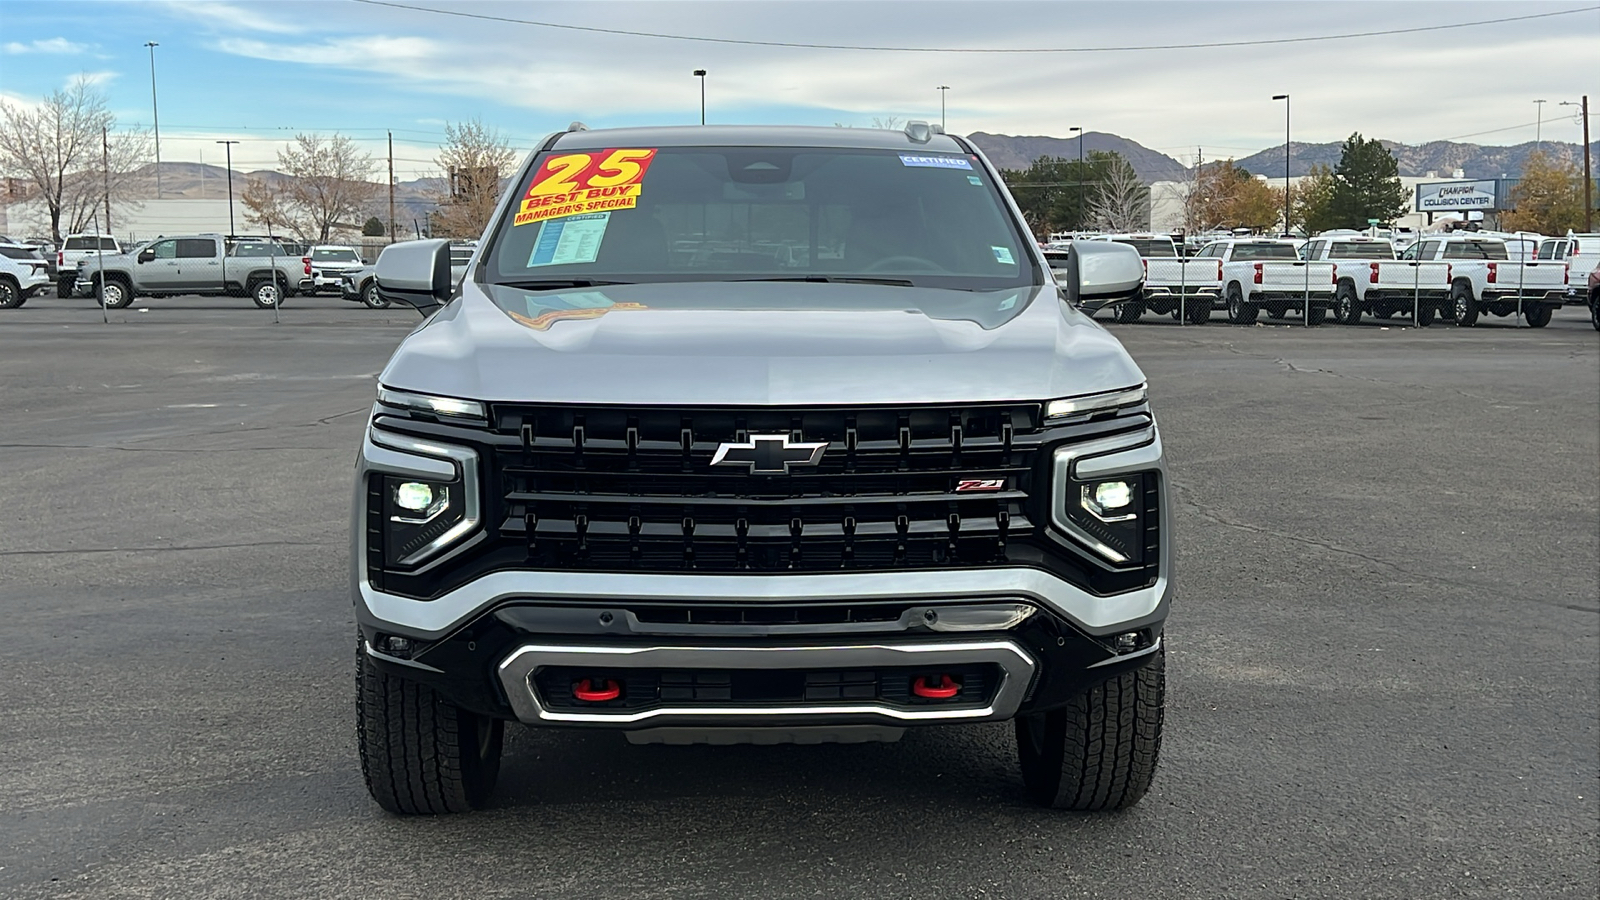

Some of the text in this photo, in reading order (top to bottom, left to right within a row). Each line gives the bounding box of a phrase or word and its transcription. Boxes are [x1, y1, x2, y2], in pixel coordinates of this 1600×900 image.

[903, 156, 966, 165] CERTIFIED
[530, 149, 653, 197] 25
[526, 185, 634, 210] BEST BUY
[1438, 186, 1475, 198] CHAMPION
[1424, 197, 1490, 207] COLLISION CENTER
[515, 197, 635, 224] MANAGER'S SPECIAL
[955, 479, 1005, 491] Z71
